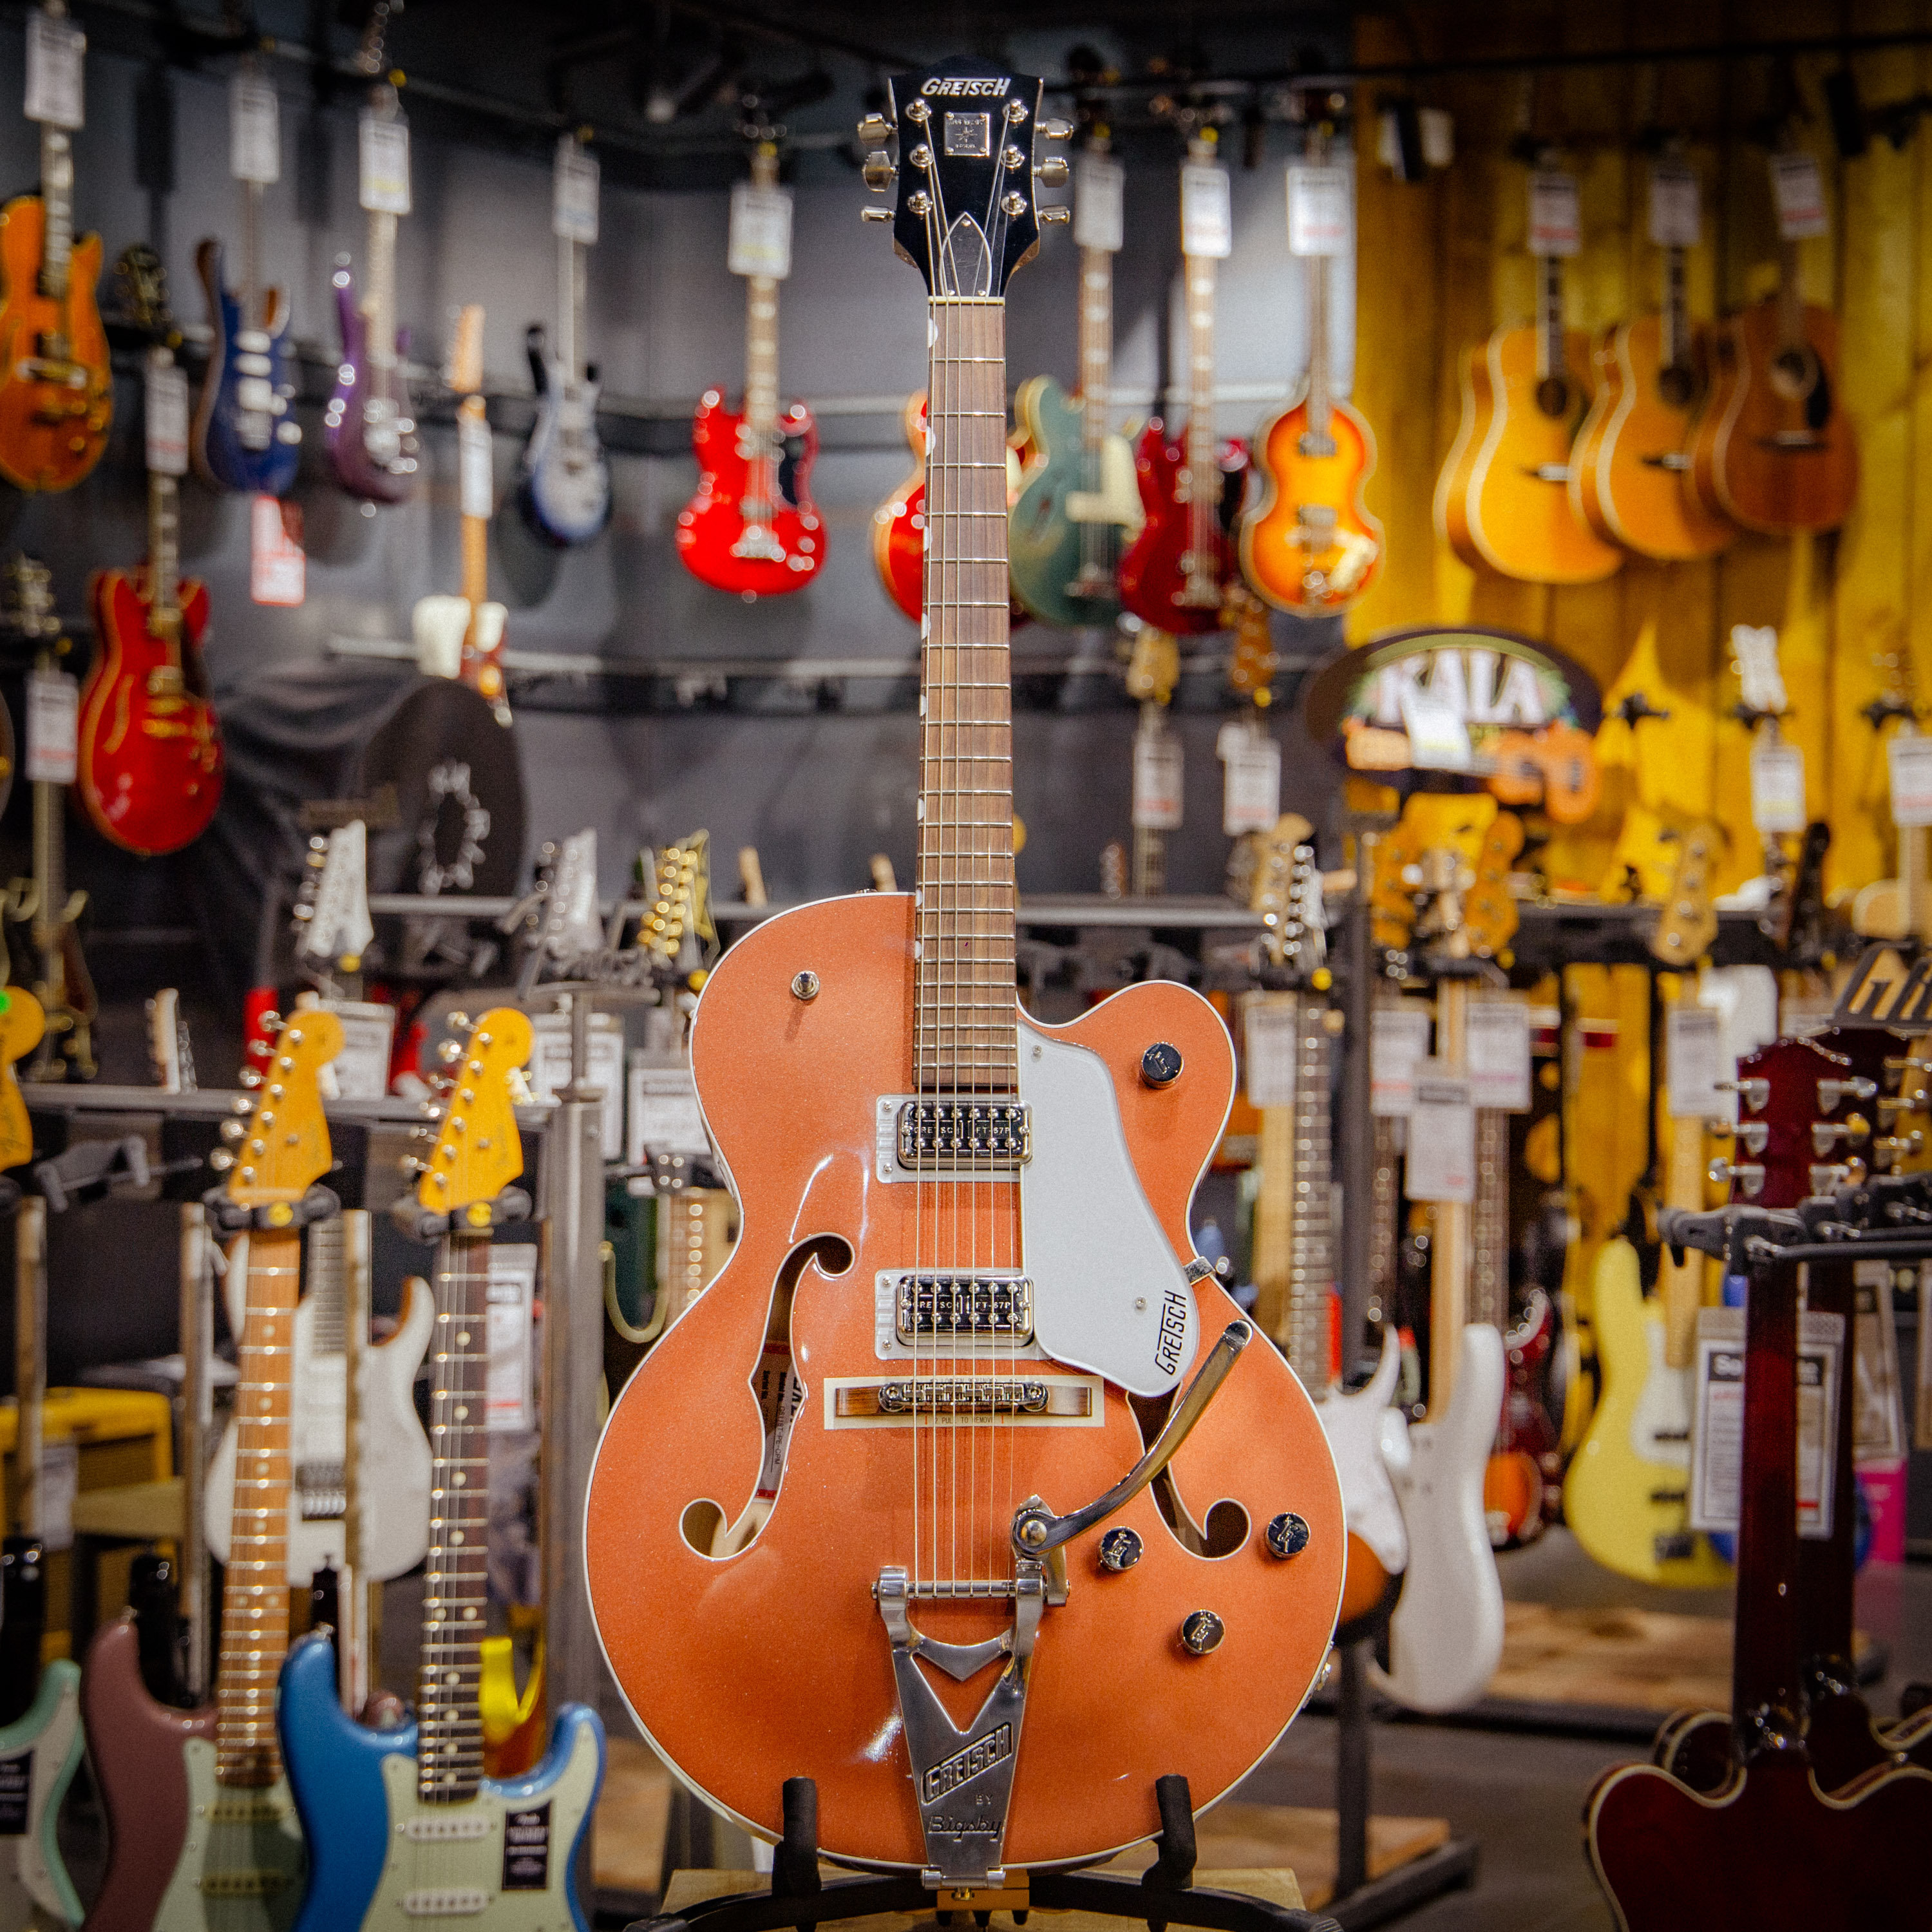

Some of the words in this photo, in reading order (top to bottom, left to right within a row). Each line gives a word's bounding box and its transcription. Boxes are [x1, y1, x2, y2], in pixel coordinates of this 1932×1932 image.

[921, 78, 1011, 96] GRETSCH
[1155, 1290, 1187, 1376] GRETSCH
[925, 1725, 1010, 1801] GRETSCH
[976, 1794, 993, 1805] BY
[928, 1815, 1003, 1842] Bigsby
